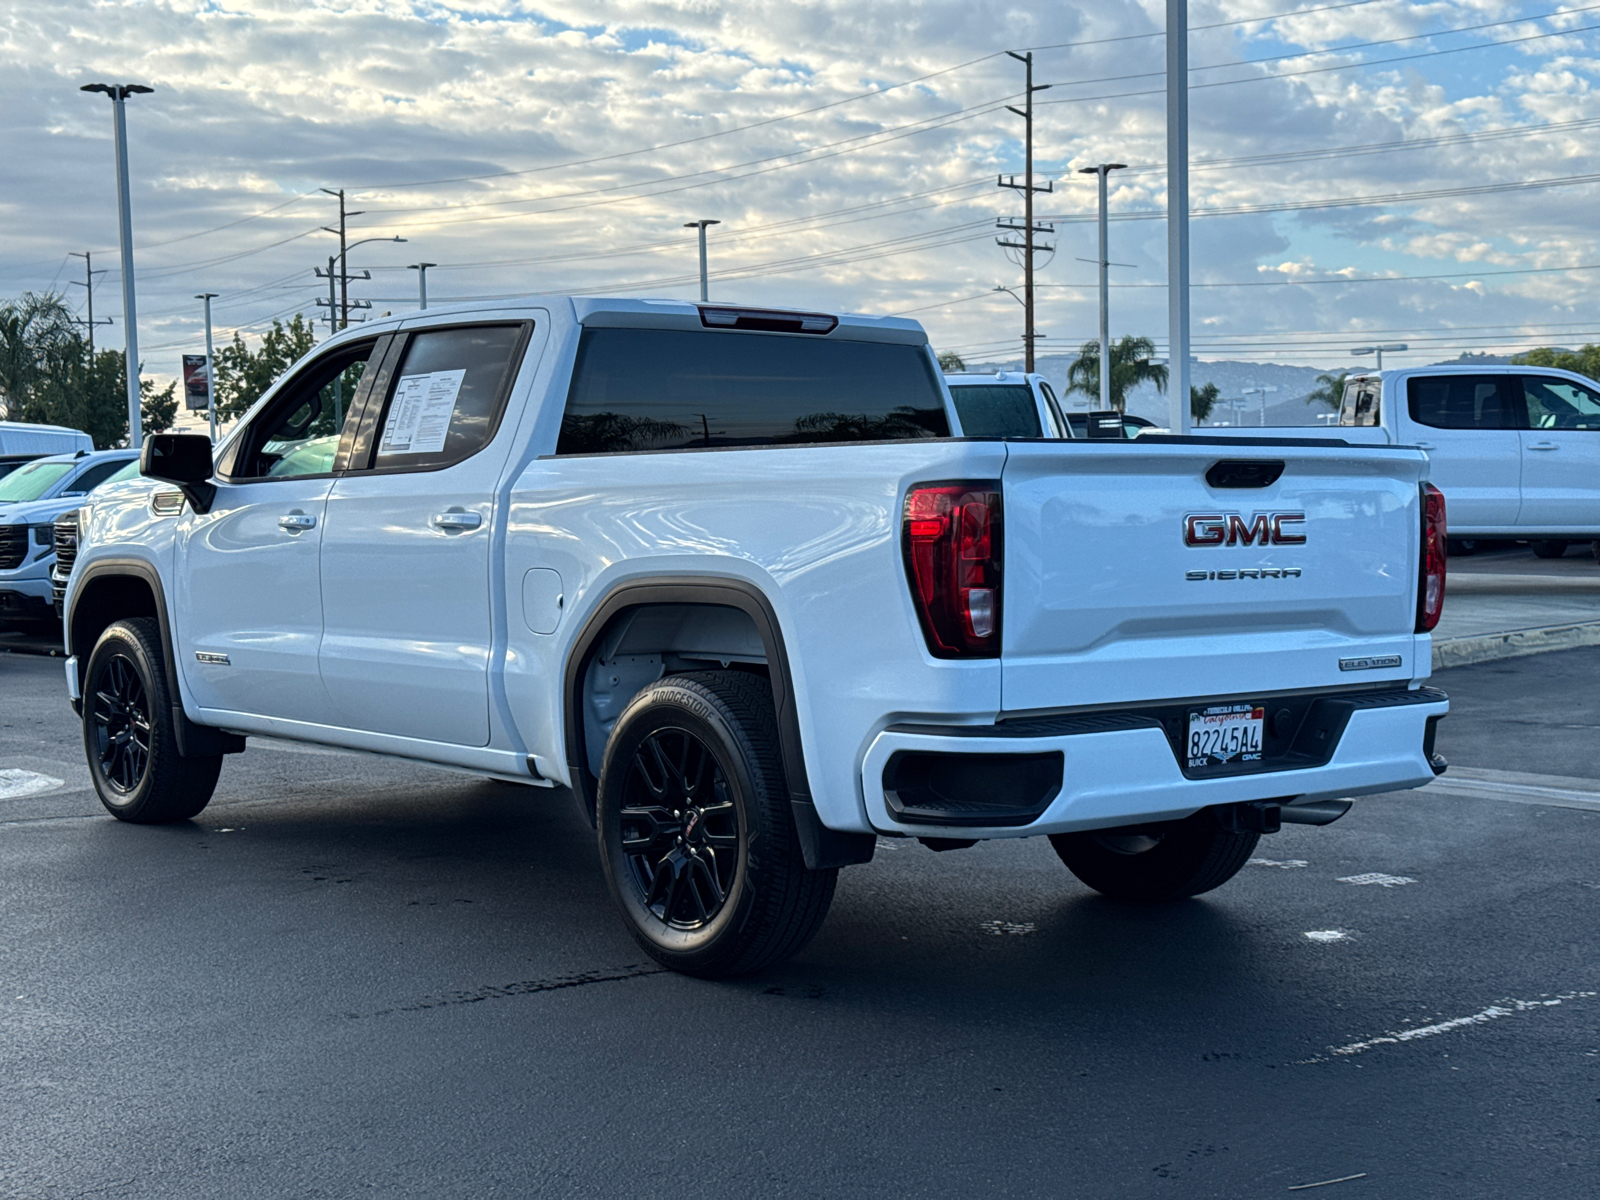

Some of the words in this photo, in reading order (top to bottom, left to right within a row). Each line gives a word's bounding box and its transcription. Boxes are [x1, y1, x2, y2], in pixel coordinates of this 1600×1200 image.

[1183, 510, 1307, 548] GMC
[1185, 567, 1302, 581] SIERRA
[1344, 657, 1398, 668] ELEVATION
[651, 689, 715, 722] BRIDGESTONE
[1203, 713, 1252, 726] California
[1190, 725, 1259, 758] 82245A4
[1188, 757, 1208, 768] BUICK
[1242, 752, 1262, 761] GMC
